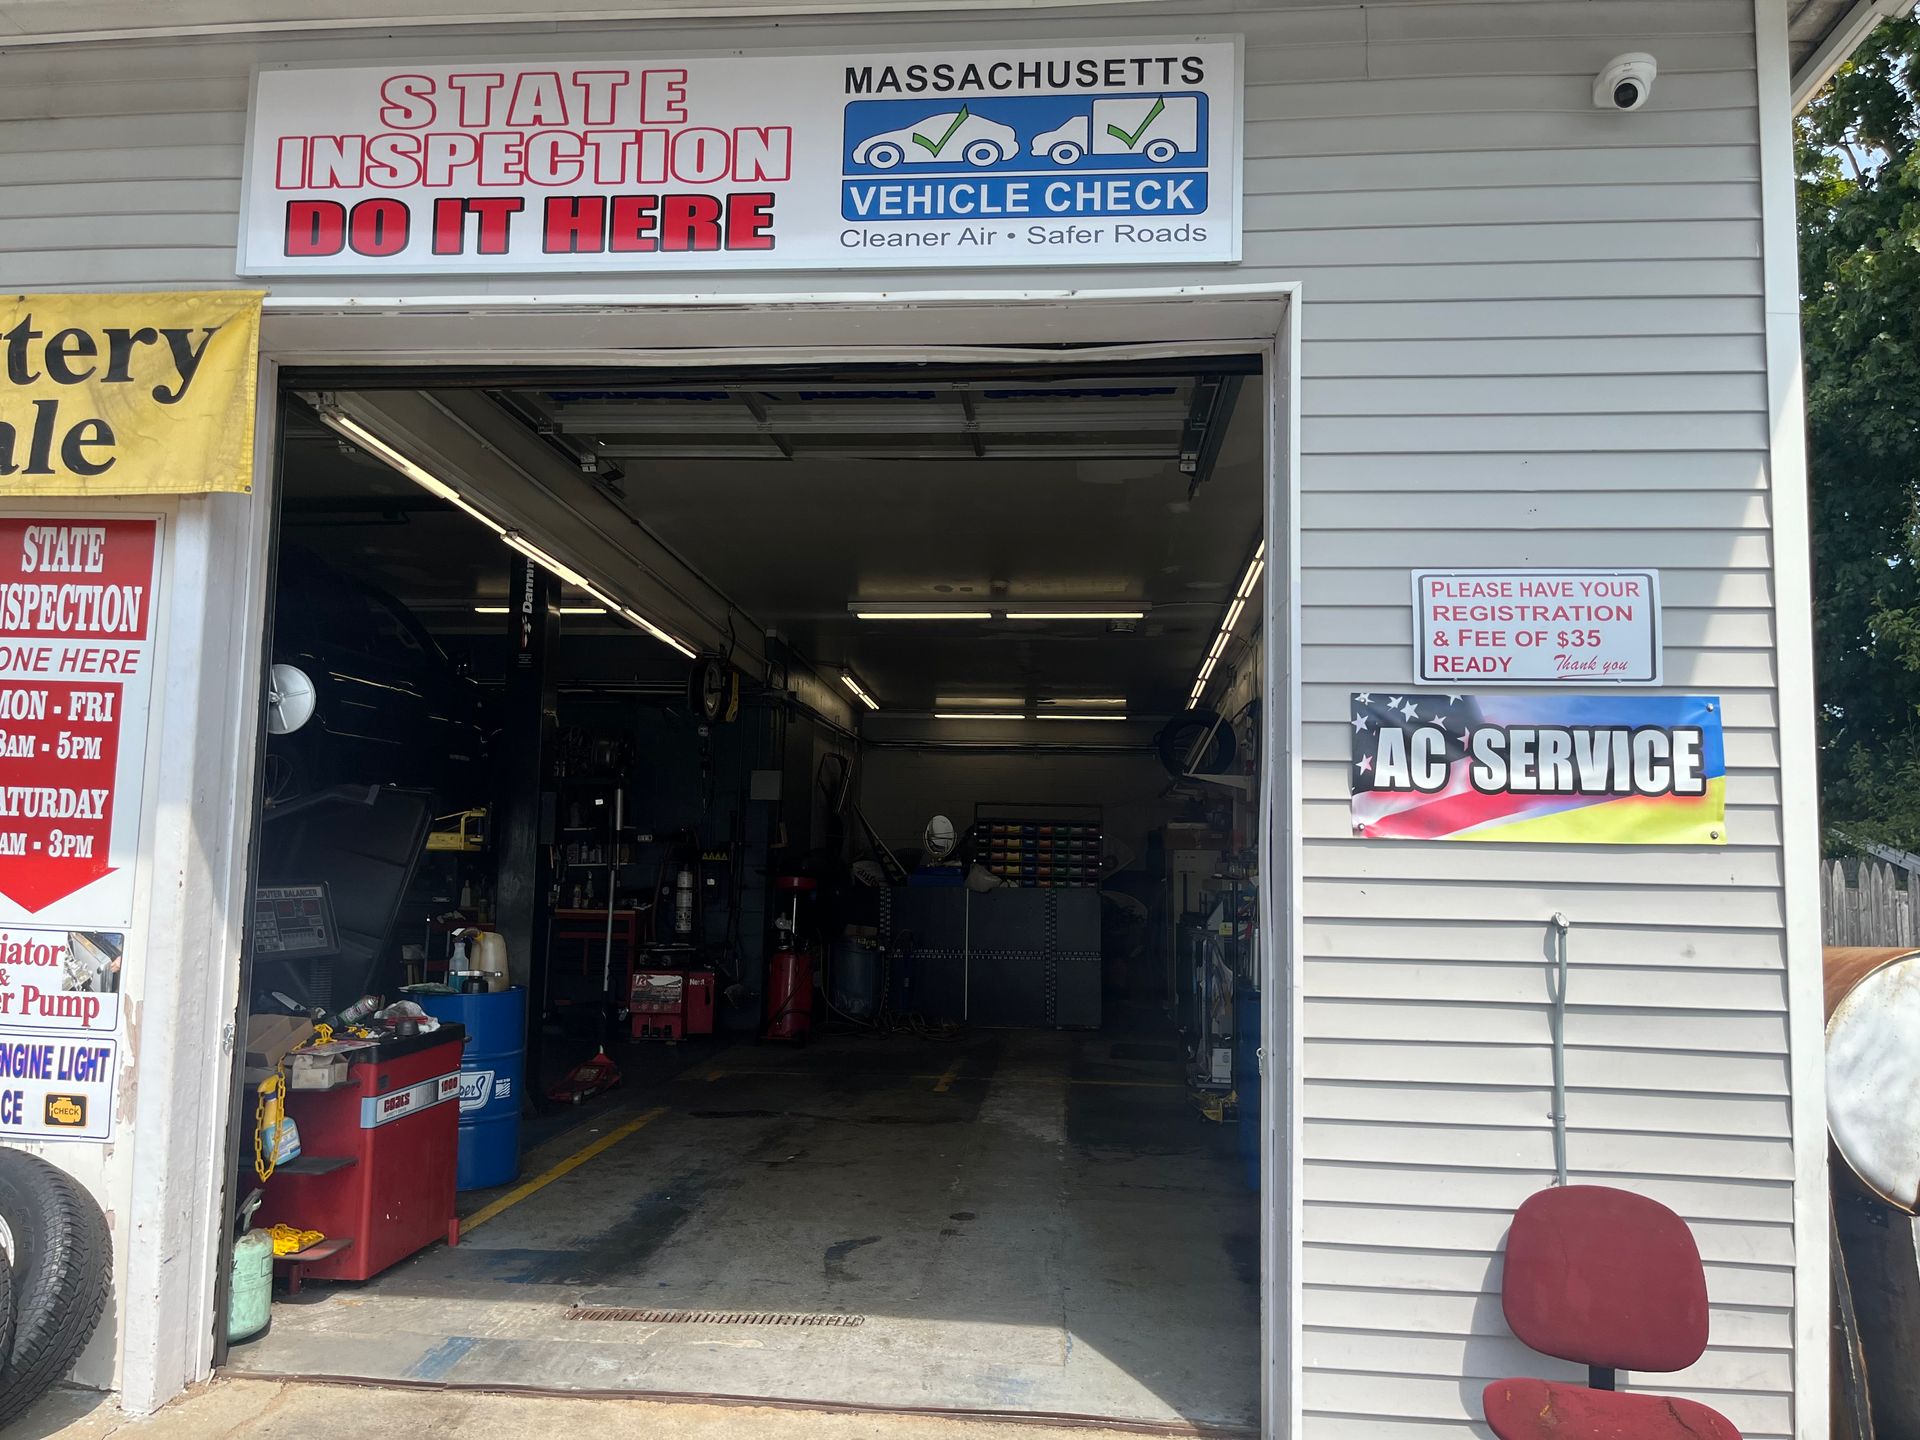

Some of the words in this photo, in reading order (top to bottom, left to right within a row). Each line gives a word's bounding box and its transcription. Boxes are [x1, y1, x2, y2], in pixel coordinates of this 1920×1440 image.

[845, 56, 1204, 94] MASSACHUSETTS
[380, 69, 687, 129] STATE
[276, 126, 792, 189] INSPECTION
[850, 182, 1030, 215] VEHICLE
[1044, 179, 1194, 212] CHECK
[284, 197, 410, 257] DO
[432, 196, 525, 256] IT
[542, 192, 776, 254] HERE
[840, 229, 951, 247] Cleaner
[958, 227, 997, 246] Air
[1027, 225, 1105, 245] Safer
[1115, 223, 1207, 243] Roads
[0, 313, 222, 405] tery
[21, 525, 106, 573] STATE
[1431, 581, 1513, 598] PLEASE
[1519, 582, 1574, 597] HAVE
[1580, 581, 1640, 597] YOUR
[1432, 605, 1633, 622] REGISTRATION
[1433, 631, 1450, 647] &
[1458, 629, 1507, 647] FEE
[1515, 631, 1548, 647] OF
[1557, 629, 1601, 649] $35
[58, 648, 141, 675] HERE
[1433, 655, 1513, 673] READY
[1554, 654, 1599, 671] Thank
[1602, 661, 1629, 676] you
[68, 691, 115, 722] FRI
[57, 731, 103, 760] 5PM
[1371, 725, 1449, 791] AC
[1471, 726, 1705, 794] SERVICE
[48, 829, 94, 858] 3PM
[19, 984, 100, 1027] Pump
[0, 1043, 55, 1081] NGINE
[57, 1046, 111, 1083] LIGHT
[0, 1089, 24, 1126] CE
[54, 1107, 79, 1116] CHECK
